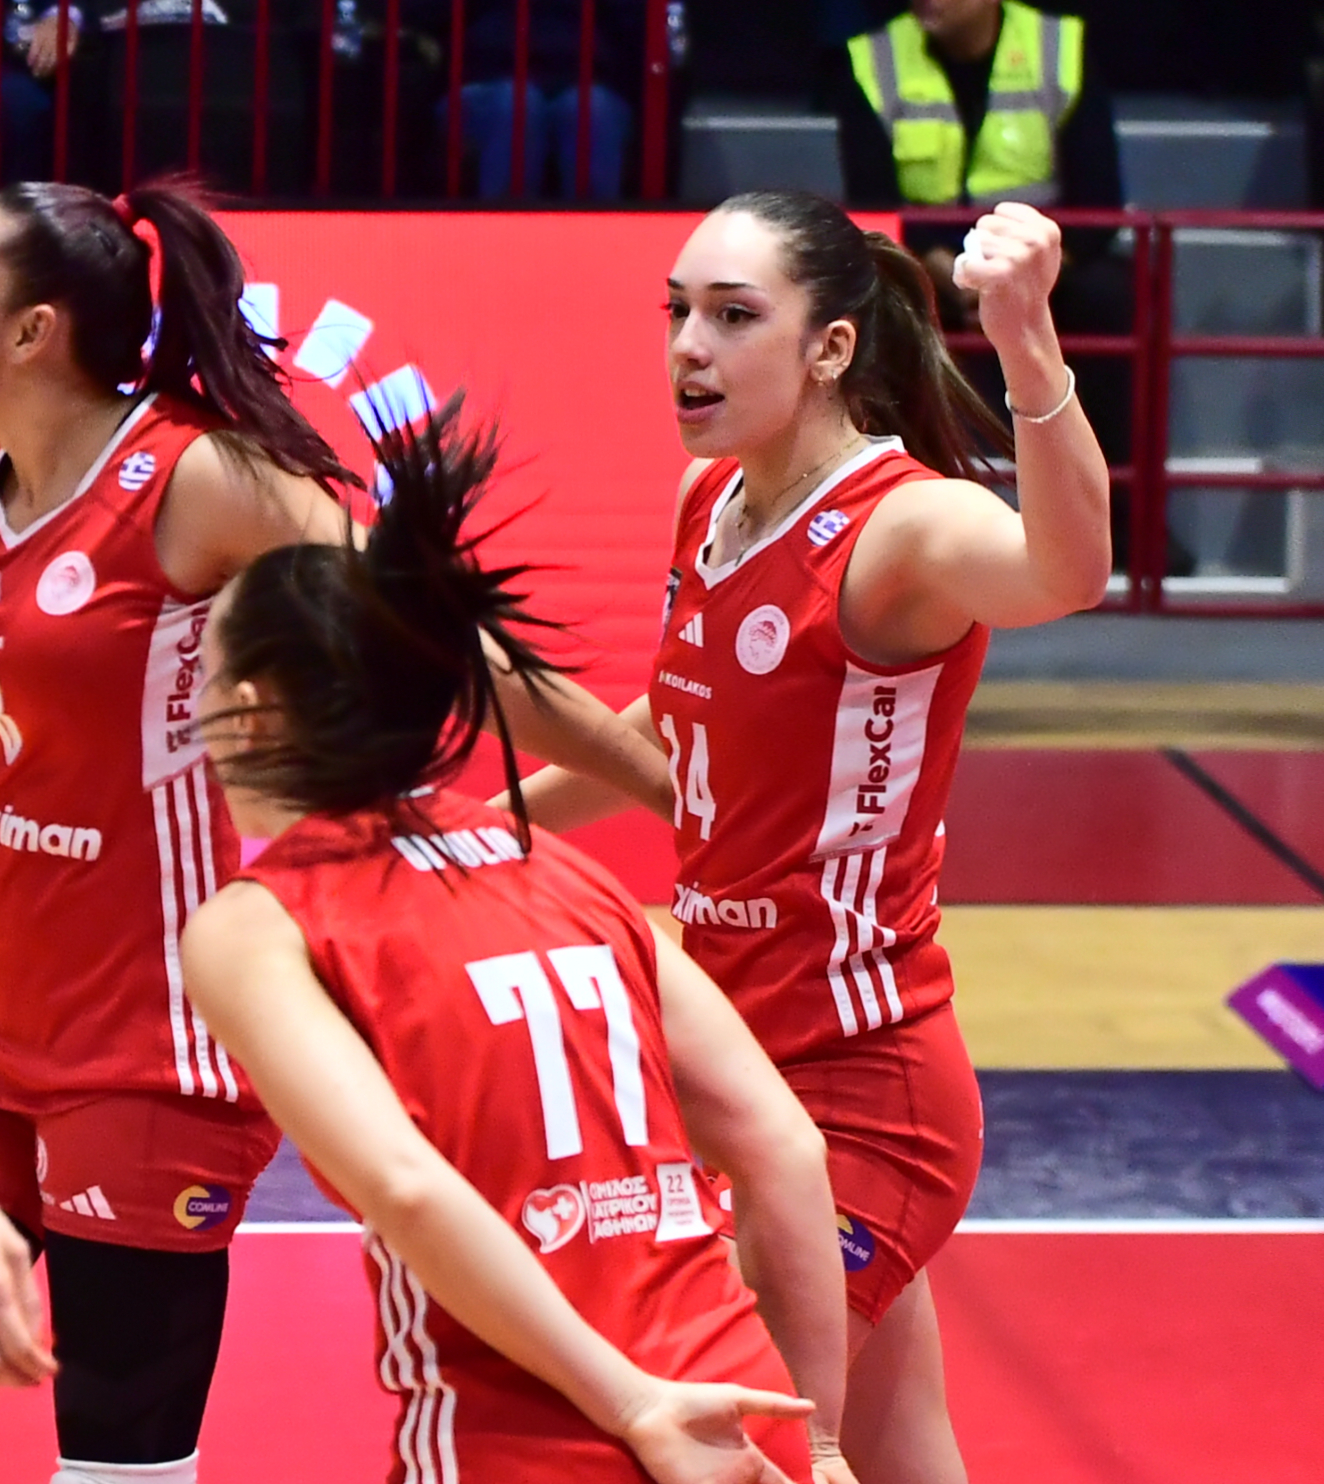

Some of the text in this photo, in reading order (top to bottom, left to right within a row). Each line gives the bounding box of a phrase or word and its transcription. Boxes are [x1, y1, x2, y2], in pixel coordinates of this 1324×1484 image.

[659, 713, 716, 841] 14
[856, 685, 897, 815] FlexCar
[464, 944, 648, 1160] 77
[666, 1174, 685, 1193] 22
[838, 1234, 870, 1261] OMLINE
